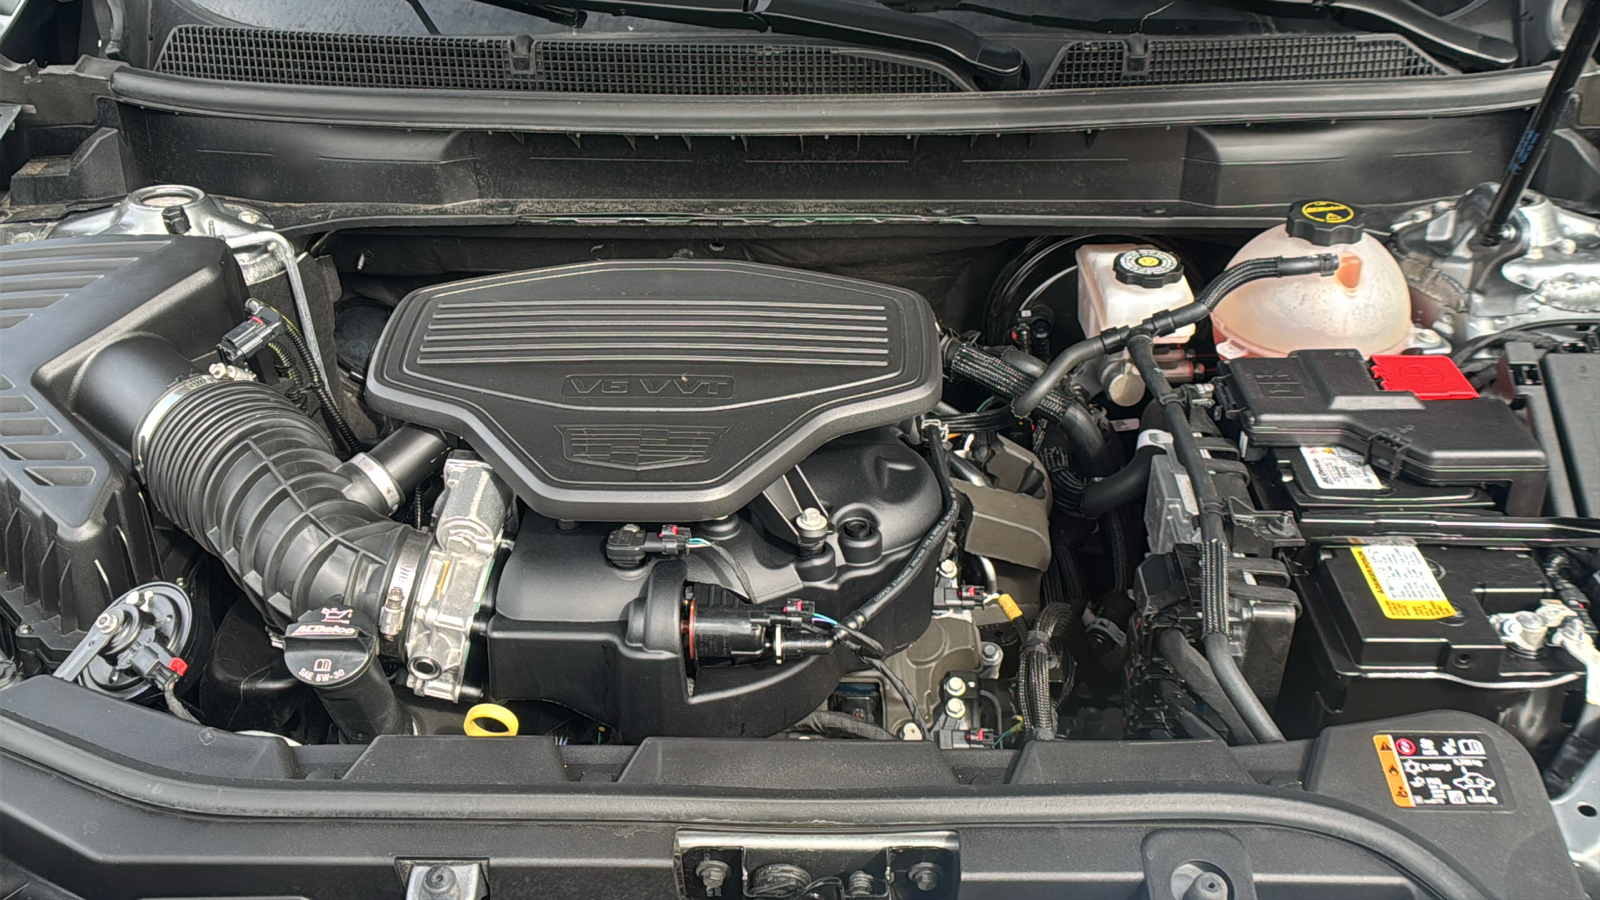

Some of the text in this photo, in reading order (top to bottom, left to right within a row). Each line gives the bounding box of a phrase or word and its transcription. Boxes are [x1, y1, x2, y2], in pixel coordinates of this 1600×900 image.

[571, 379, 729, 395] V6 VVT
[291, 625, 356, 636] ACDelco
[299, 668, 315, 680] SAE
